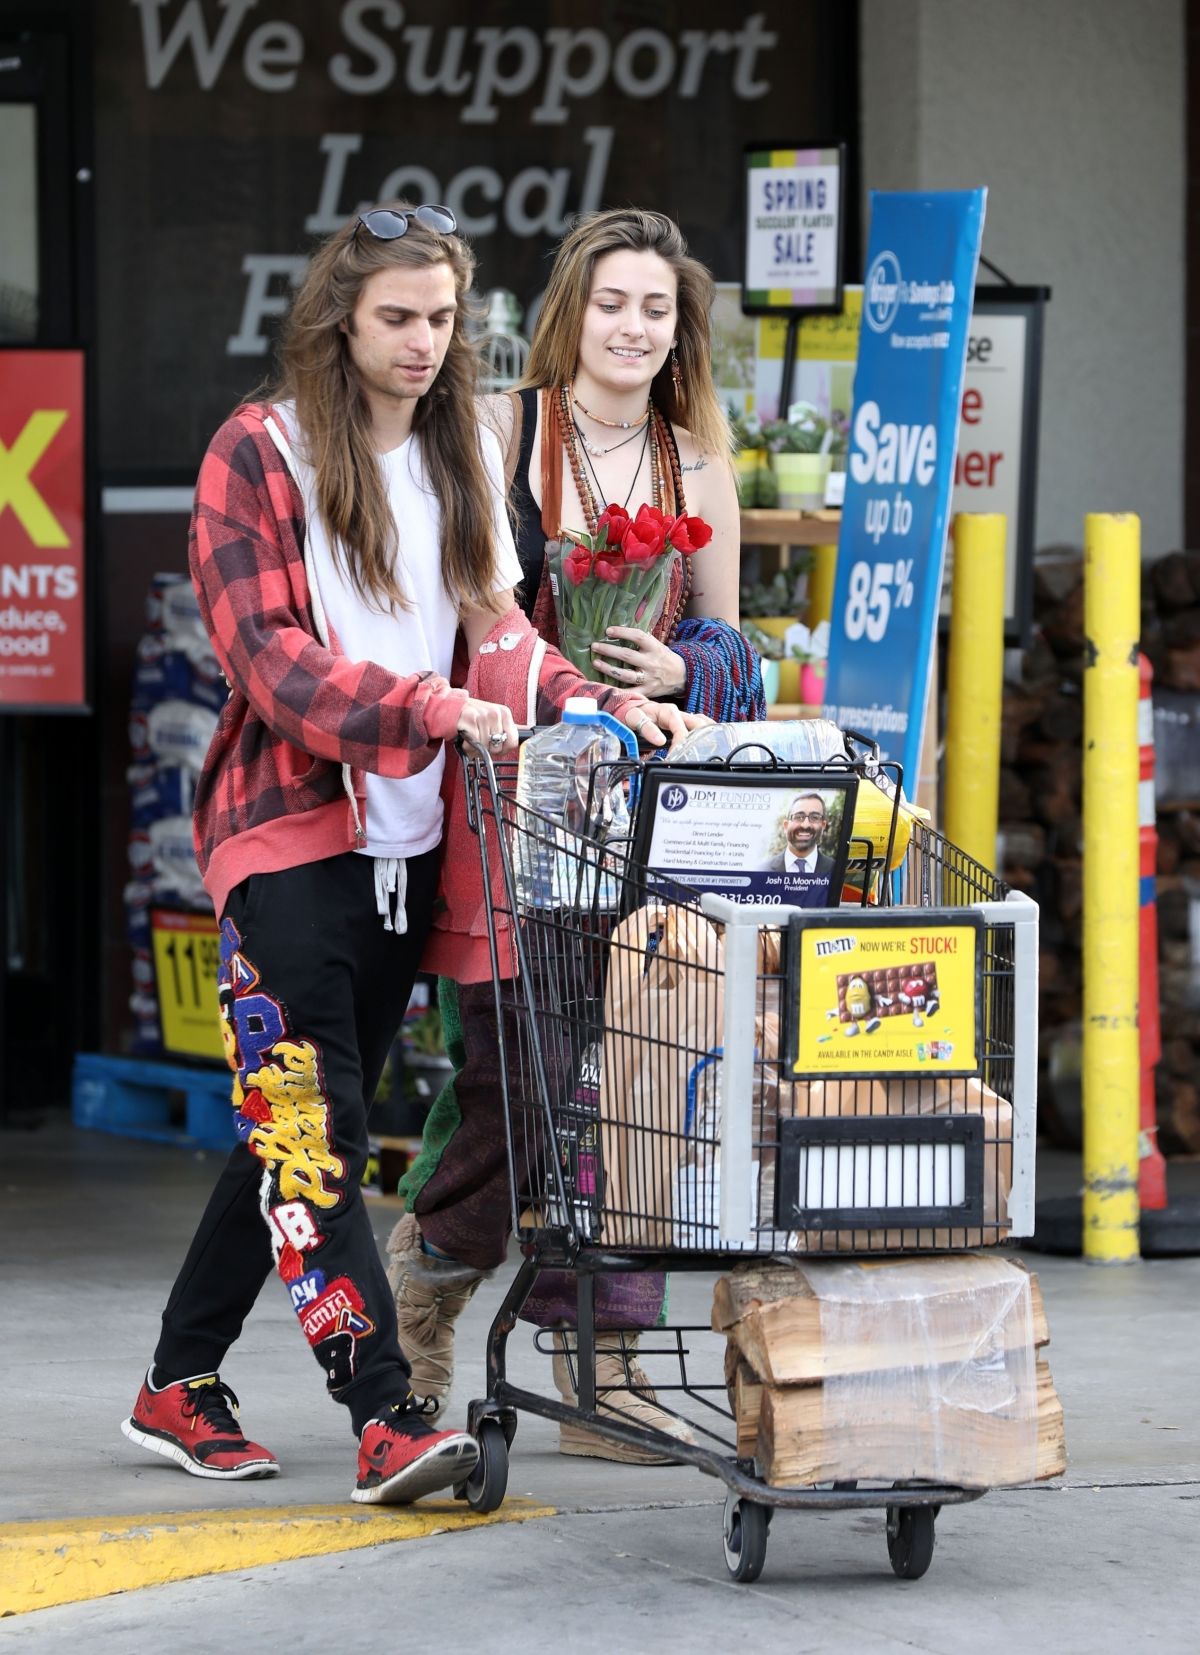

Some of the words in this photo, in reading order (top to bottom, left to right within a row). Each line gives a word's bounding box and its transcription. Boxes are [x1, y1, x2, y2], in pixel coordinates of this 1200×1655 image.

[133, 0, 303, 90] We
[329, 0, 778, 123] Support
[305, 128, 615, 237] Local
[763, 179, 827, 211] SPRING
[774, 232, 816, 264] SALE
[851, 400, 938, 486] Save
[864, 497, 889, 544] up
[892, 491, 913, 537] to
[844, 558, 915, 643] 85%
[690, 790, 716, 801] JDM
[719, 791, 771, 803] FUNDING
[766, 876, 782, 885] Josh
[792, 877, 830, 886] Moorvitch
[784, 884, 809, 892] President
[860, 942, 881, 952] NOW
[882, 940, 907, 952] WE'RE
[910, 937, 957, 954] STUCK!
[817, 1050, 850, 1059] AVAILABLE
[852, 1050, 859, 1058] IN
[861, 1050, 872, 1058] THE
[874, 1049, 894, 1058] CANDY
[895, 1049, 913, 1057] AISLE
